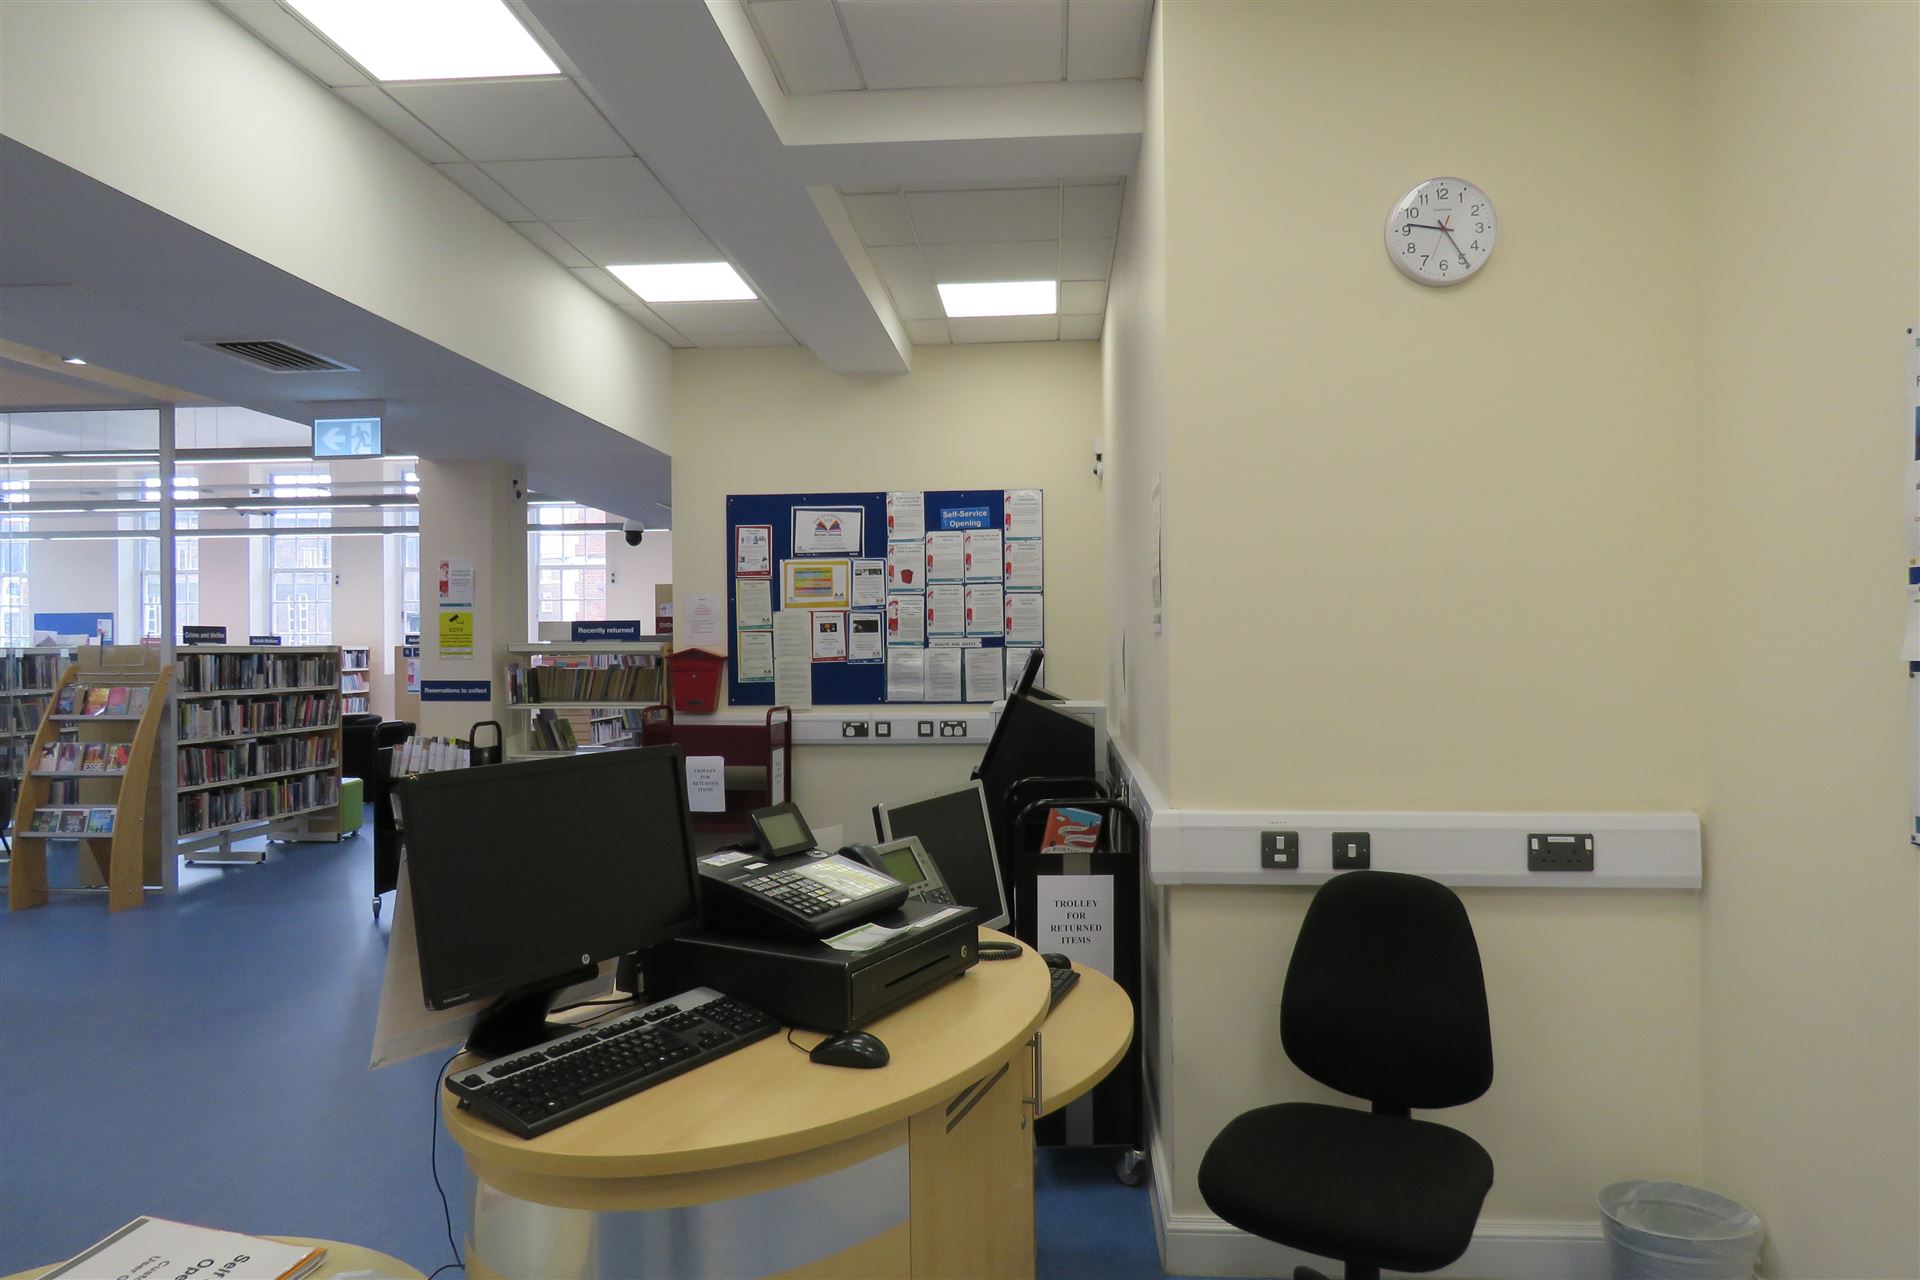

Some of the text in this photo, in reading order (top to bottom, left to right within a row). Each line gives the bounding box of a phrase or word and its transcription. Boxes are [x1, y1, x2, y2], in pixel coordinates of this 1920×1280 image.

[1419, 194, 1429, 205] 11
[1436, 188, 1448, 200] 12
[1405, 207, 1419, 219] 10
[1471, 205, 1480, 216] 2
[1401, 224, 1411, 236] 9
[1475, 222, 1484, 233] 3
[1407, 242, 1416, 254] 8
[1470, 240, 1479, 251] 4
[1420, 255, 1429, 267] 7
[1458, 253, 1467, 265] 5
[1439, 259, 1449, 271] 6
[942, 510, 988, 518] Self-Service
[949, 519, 982, 528] Opening
[1054, 899, 1098, 908] TROLLEY
[1066, 912, 1086, 920] FOR
[1050, 924, 1102, 932] RETURNED
[1061, 936, 1092, 945] ITEMS
[213, 1254, 251, 1278] Self
